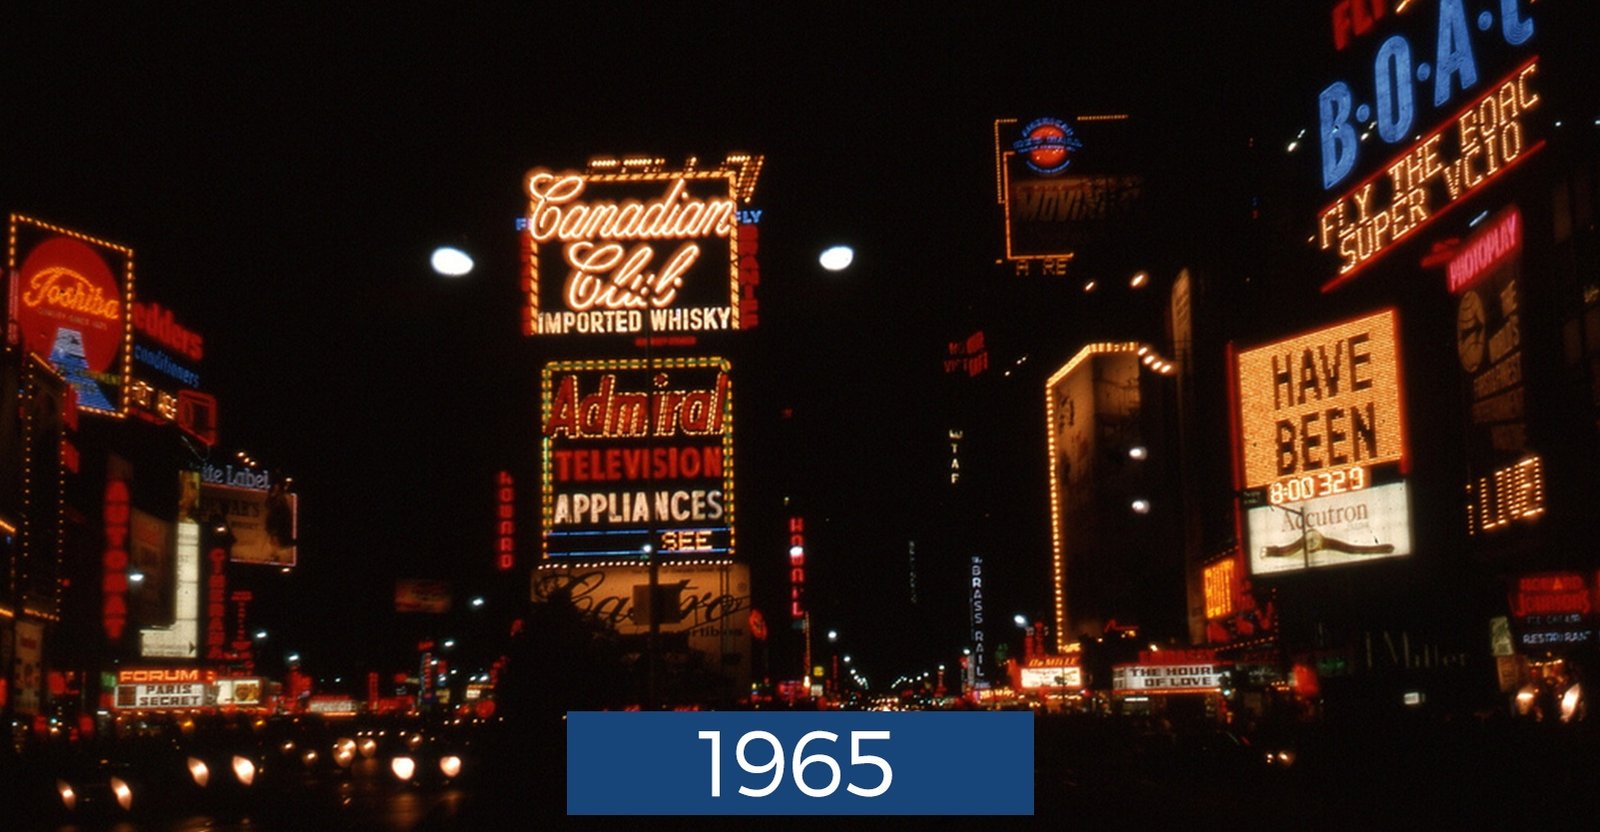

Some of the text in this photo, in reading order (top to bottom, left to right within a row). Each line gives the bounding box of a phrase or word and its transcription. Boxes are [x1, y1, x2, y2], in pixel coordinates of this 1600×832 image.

[528, 172, 737, 241] Canadian
[1320, 184, 1372, 249] FLY
[1387, 134, 1444, 200] THE
[1339, 188, 1428, 274] SUPER
[1450, 211, 1518, 292] PHOTOPLAY
[22, 266, 119, 319] Toshiba
[568, 241, 700, 310] Club
[133, 301, 205, 362] edders
[537, 307, 732, 334] IMPORTED WHISKY
[1272, 332, 1373, 410] HAVE
[550, 371, 732, 439] Admiral
[1276, 402, 1378, 475] BEEN
[226, 464, 272, 490] Label
[555, 446, 723, 482] TELEVISION
[554, 490, 723, 524] APPLIANCES
[1270, 476, 1315, 505] 8:00
[1281, 502, 1369, 533] Accutron
[661, 530, 714, 551] SEE
[971, 565, 983, 624] BRASS
[974, 631, 985, 677] RAIL
[1129, 666, 1211, 677] THE HOUR
[119, 669, 199, 682] FORUM
[146, 684, 192, 695] PARIS
[1144, 676, 1212, 686] OF LOVE
[139, 695, 201, 706] SECRET
